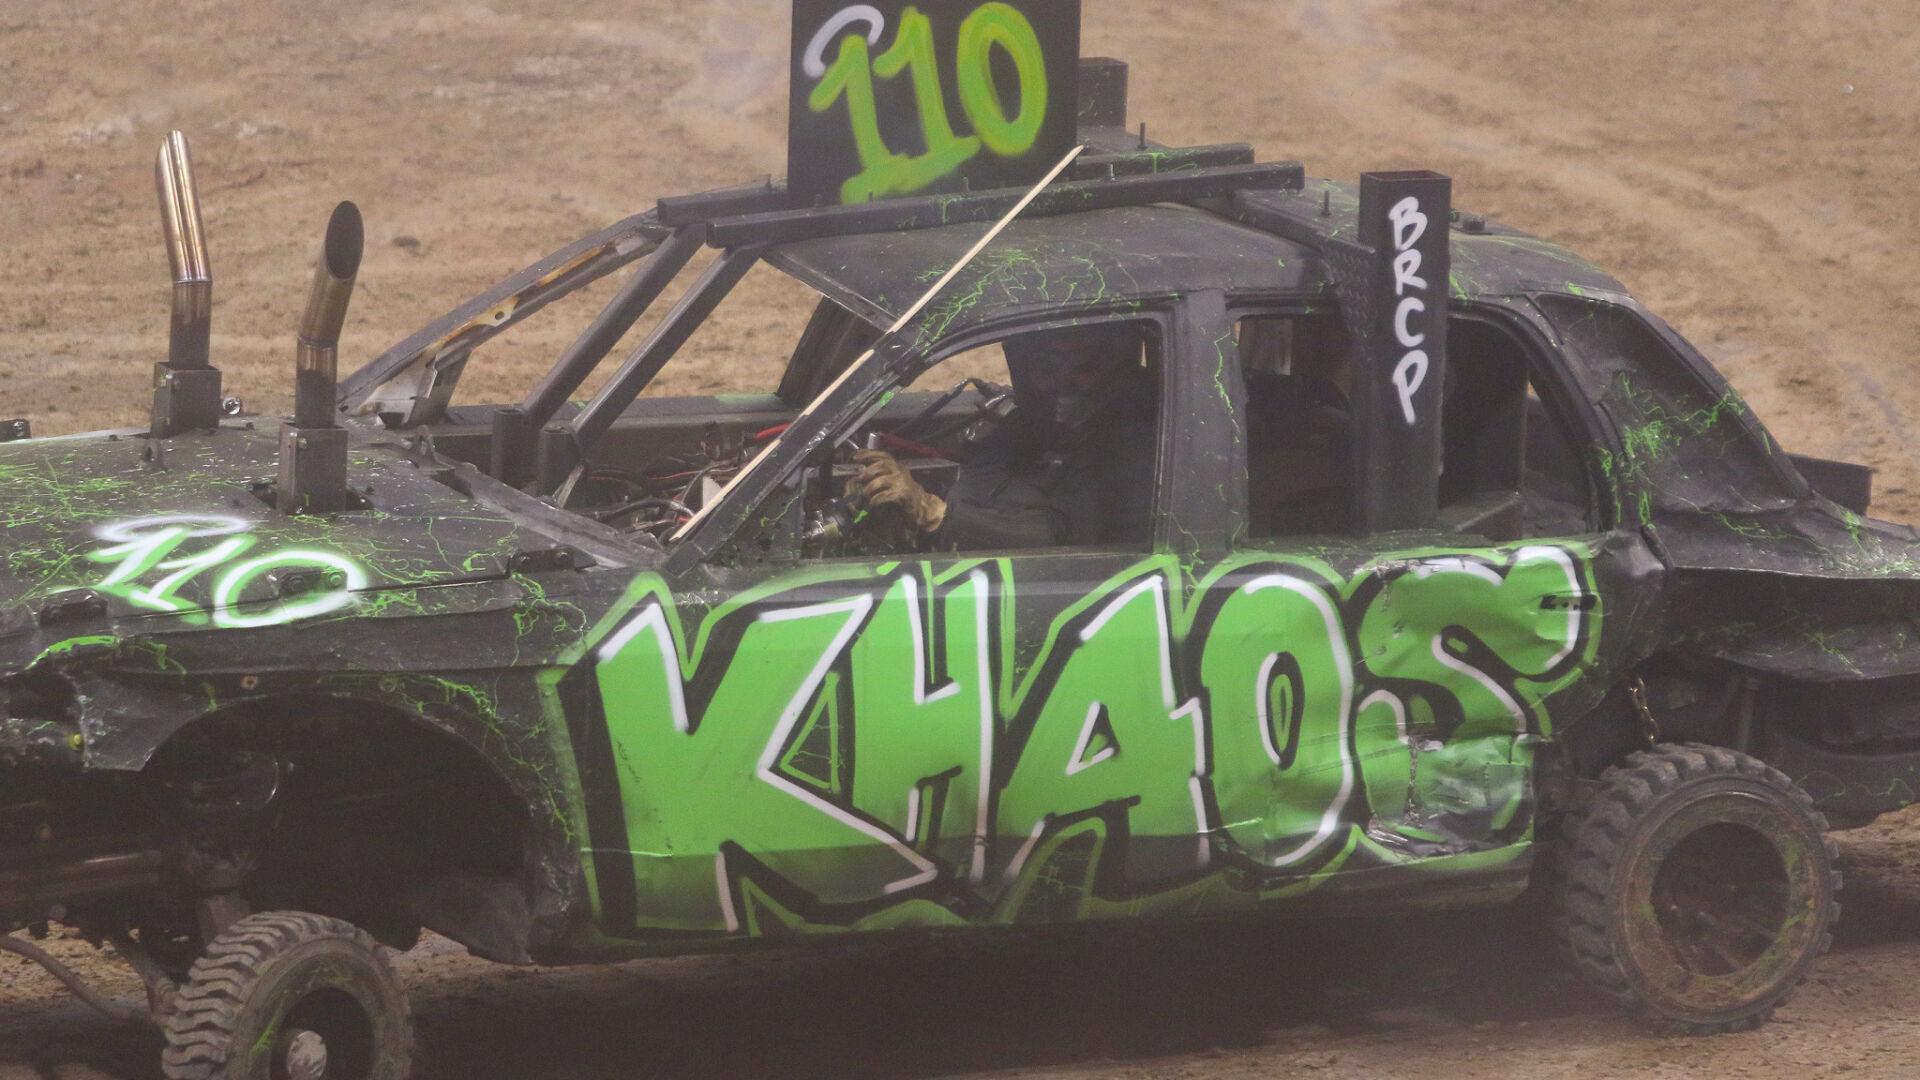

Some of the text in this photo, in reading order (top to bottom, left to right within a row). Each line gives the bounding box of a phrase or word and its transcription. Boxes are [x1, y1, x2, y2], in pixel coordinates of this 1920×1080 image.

[808, 2, 1048, 205] 110
[1389, 196, 1429, 424] BRCP
[545, 540, 1600, 937] KHAOS
